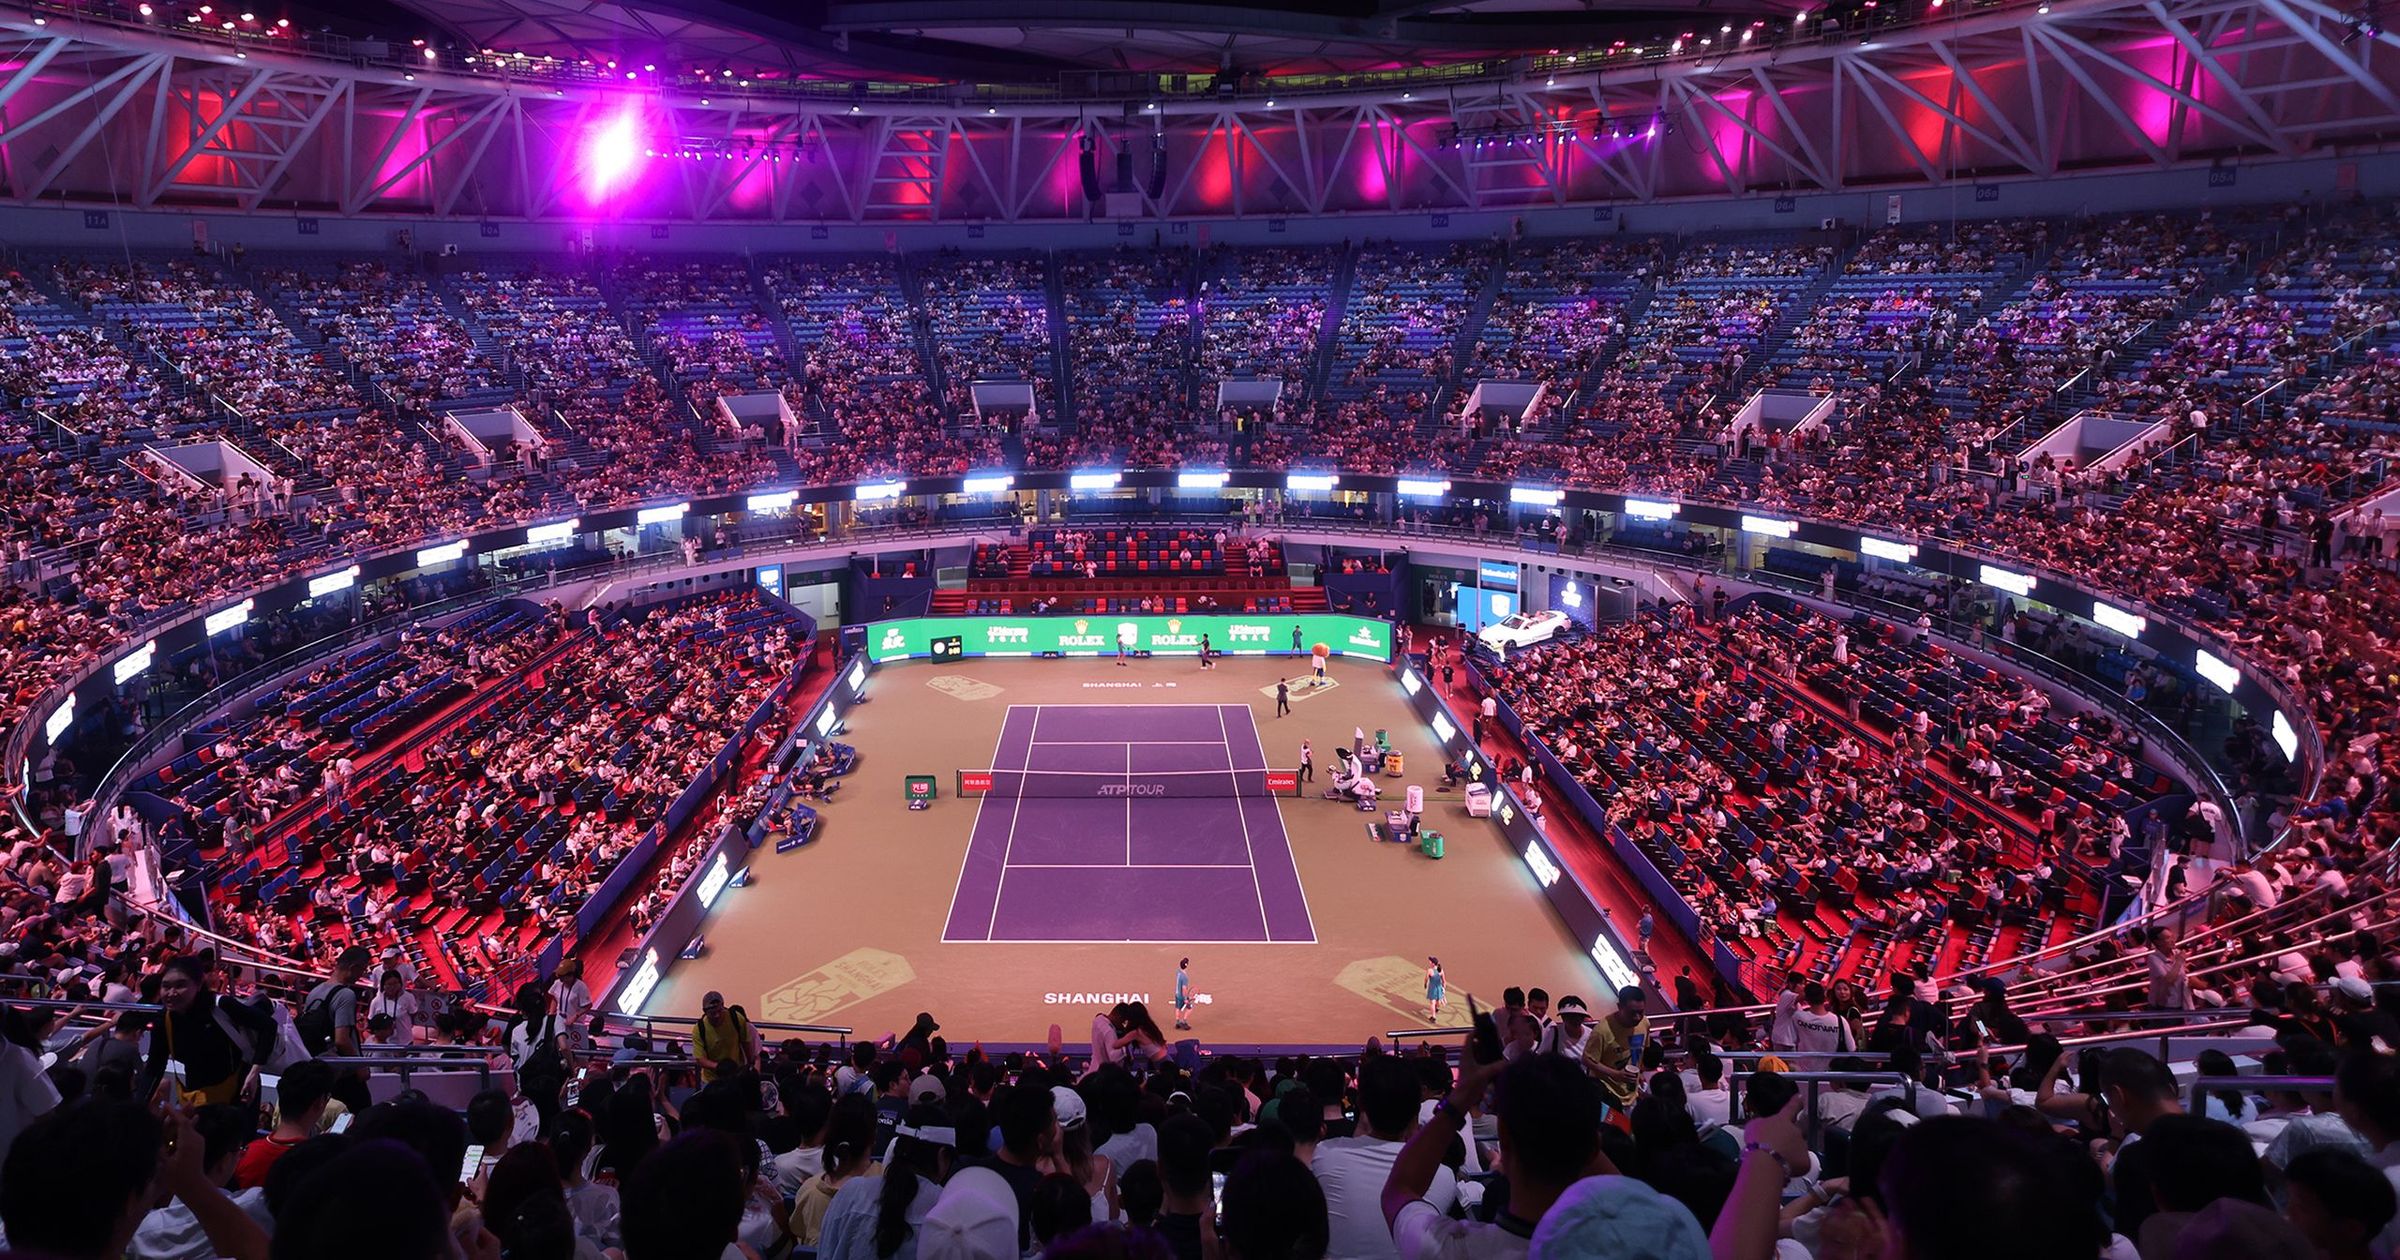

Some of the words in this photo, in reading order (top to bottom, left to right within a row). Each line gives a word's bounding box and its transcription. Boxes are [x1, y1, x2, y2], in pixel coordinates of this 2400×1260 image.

[2210, 172, 2234, 183] 05A
[1977, 188, 1998, 199] 06B
[88, 215, 107, 225] 11A
[300, 222, 318, 231] 11B
[483, 226, 498, 234] 10A
[1058, 635, 1105, 646] ROLEX
[1151, 635, 1198, 646] ROLEX
[1097, 784, 1126, 795] ATP
[1129, 784, 1165, 795] TOUR
[1044, 993, 1149, 1004] SHANGHAI
